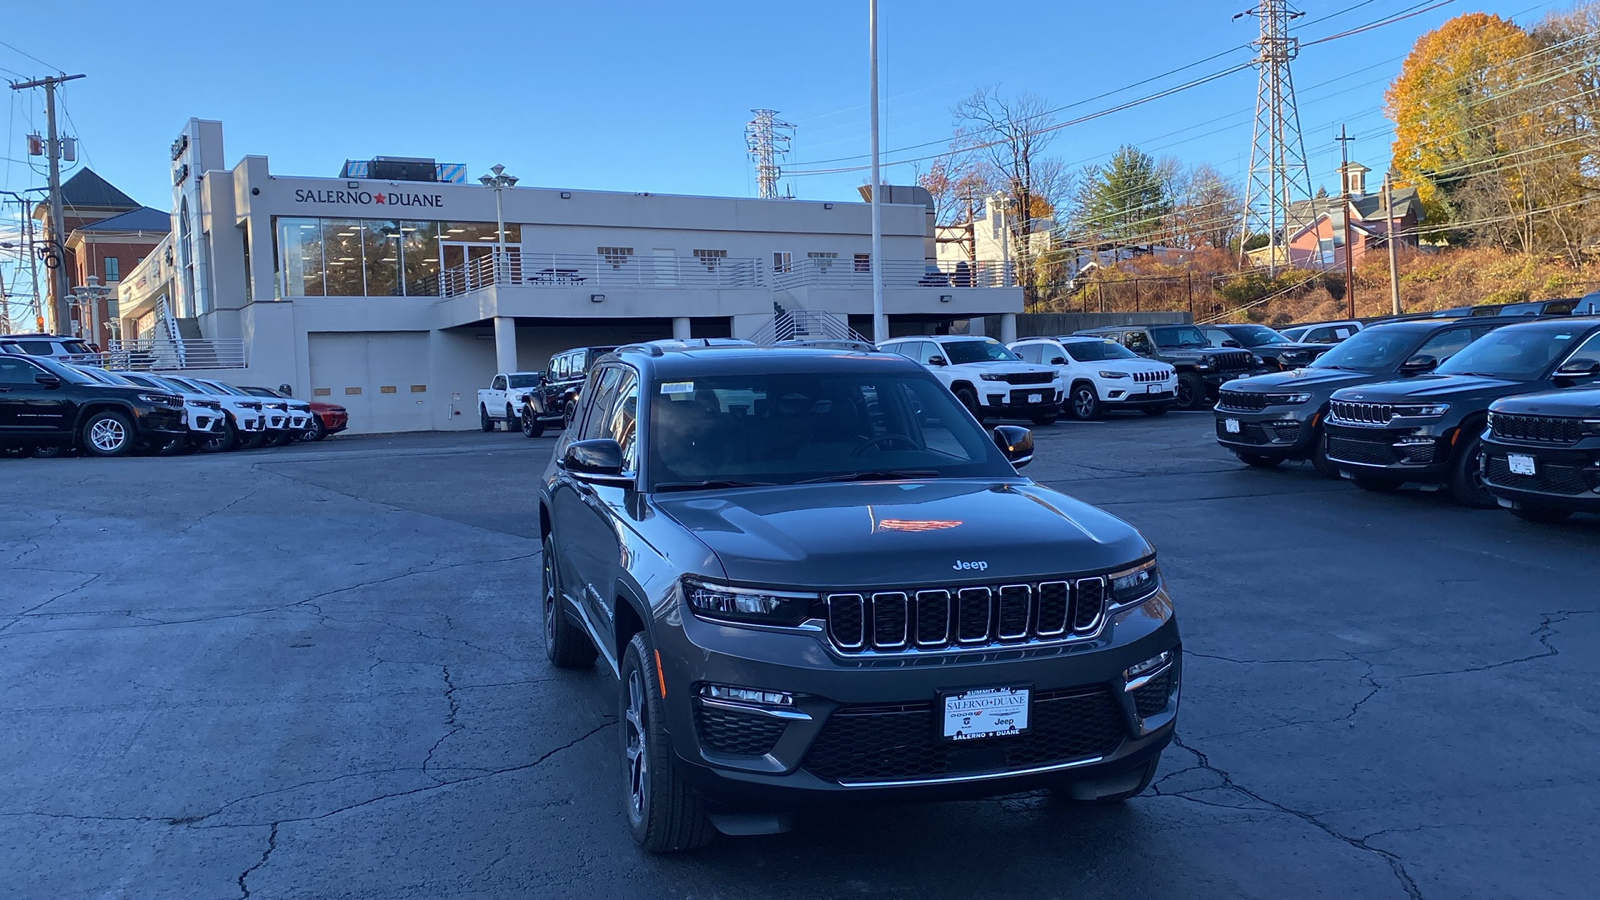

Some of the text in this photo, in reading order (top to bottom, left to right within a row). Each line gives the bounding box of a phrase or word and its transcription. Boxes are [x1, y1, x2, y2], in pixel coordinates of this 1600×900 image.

[295, 189, 443, 207] SALERNO DUANE
[952, 559, 988, 571] Jeep
[947, 699, 989, 711] SALERNO
[993, 696, 1026, 707] DUANE
[994, 718, 1014, 726] Jeep
[952, 732, 986, 741] SALERNO
